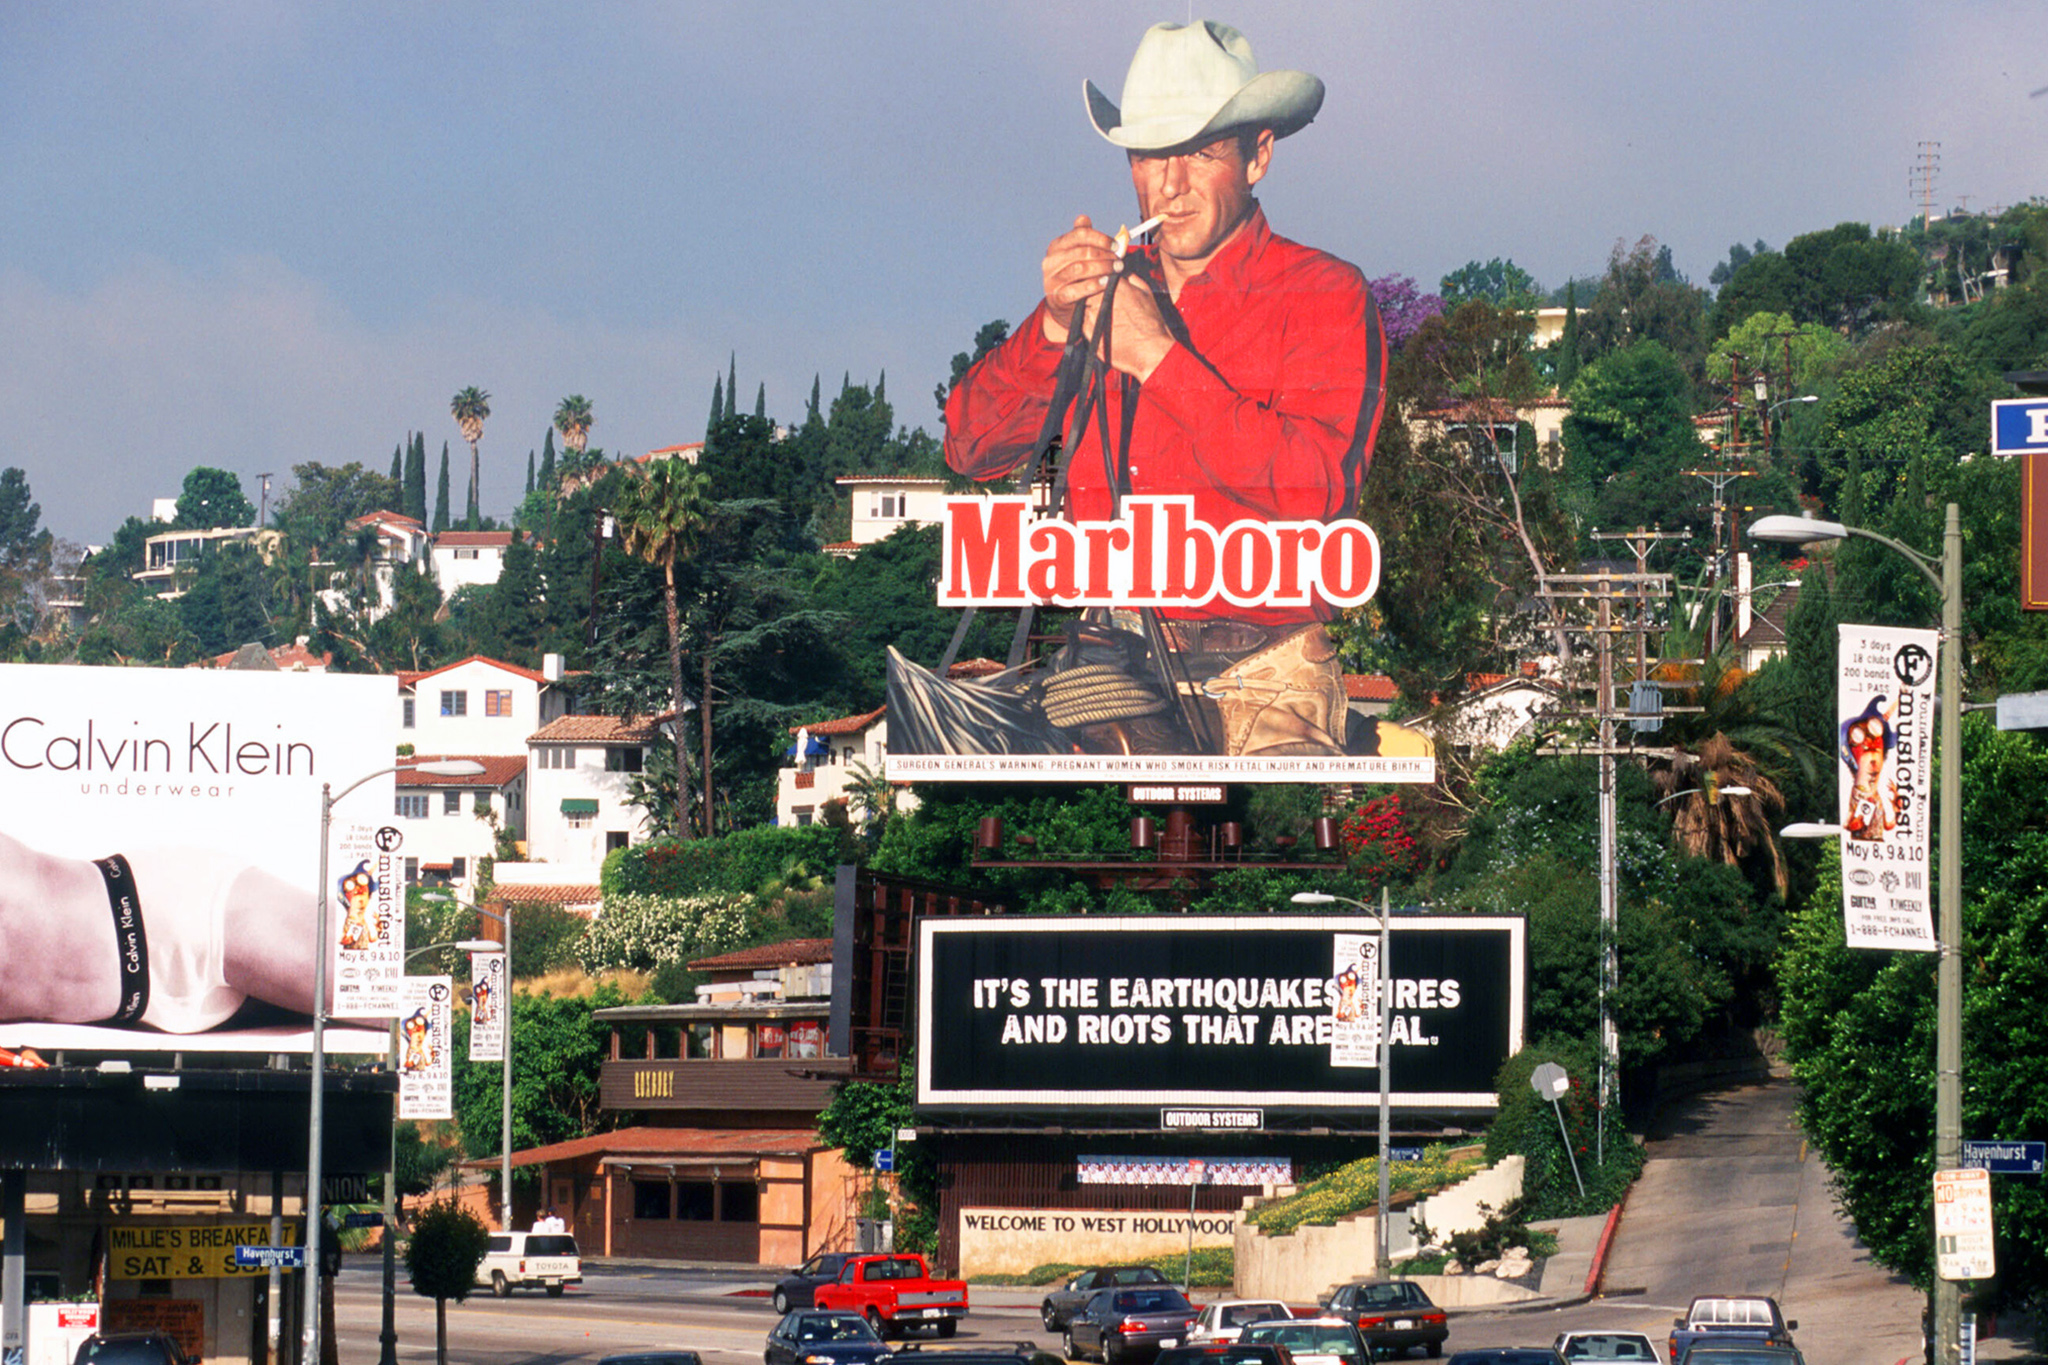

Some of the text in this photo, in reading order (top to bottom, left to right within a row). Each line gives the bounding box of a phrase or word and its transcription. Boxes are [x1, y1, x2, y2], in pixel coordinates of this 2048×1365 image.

[945, 500, 1374, 602] Marlboro
[1860, 639, 1867, 649] 3
[1844, 667, 1890, 679] 200 bands
[1867, 683, 1890, 694] PASS
[2, 717, 314, 776] Calvin Klein
[897, 760, 941, 769] SURGEON
[944, 760, 996, 770] GENERAL'S
[1051, 761, 1101, 770] PREGNANT
[1106, 761, 1141, 770] WOMEN
[1146, 761, 1167, 770] WHO
[1171, 761, 1204, 770] SMOKE
[1208, 761, 1231, 770] RISK
[1235, 761, 1262, 771] FETAL
[1266, 761, 1300, 771] INJURY
[1305, 762, 1325, 771] AND
[1329, 762, 1387, 771] PREMATURE
[1896, 689, 1916, 839] musicfest
[81, 778, 235, 797] underwear
[1133, 787, 1222, 801] OUTDOOR SYSTEMS
[1846, 842, 1924, 862] May 8, 9 & 10
[378, 856, 392, 948] musicfest
[120, 896, 139, 974] Calvin Klein
[339, 952, 356, 967] May
[371, 953, 377, 963] 9
[388, 951, 400, 962] 10
[973, 978, 1030, 1008] IT'S
[1041, 978, 1099, 1008] THE
[431, 1003, 442, 1068] musicfest
[1001, 1014, 1068, 1045] AND
[1078, 1014, 1172, 1045] RIOTS
[1182, 1014, 1260, 1044] THAT
[1269, 1014, 1332, 1045] ARE
[1166, 1112, 1258, 1127] OUTDOOR SYSTEMS
[1963, 1143, 2026, 1160] Havenhurst
[2031, 1159, 2041, 1171] Dr
[321, 1175, 367, 1200] NION
[1937, 1185, 1954, 1202] NO
[964, 1215, 1047, 1232] WELCOME
[1052, 1216, 1076, 1232] TO
[1081, 1217, 1127, 1233] WEST
[112, 1225, 292, 1249] MILLIE'S BREAKFAT
[243, 1247, 295, 1260] Havenhurst
[187, 1256, 204, 1275] &
[535, 1262, 569, 1271] TOYOTA
